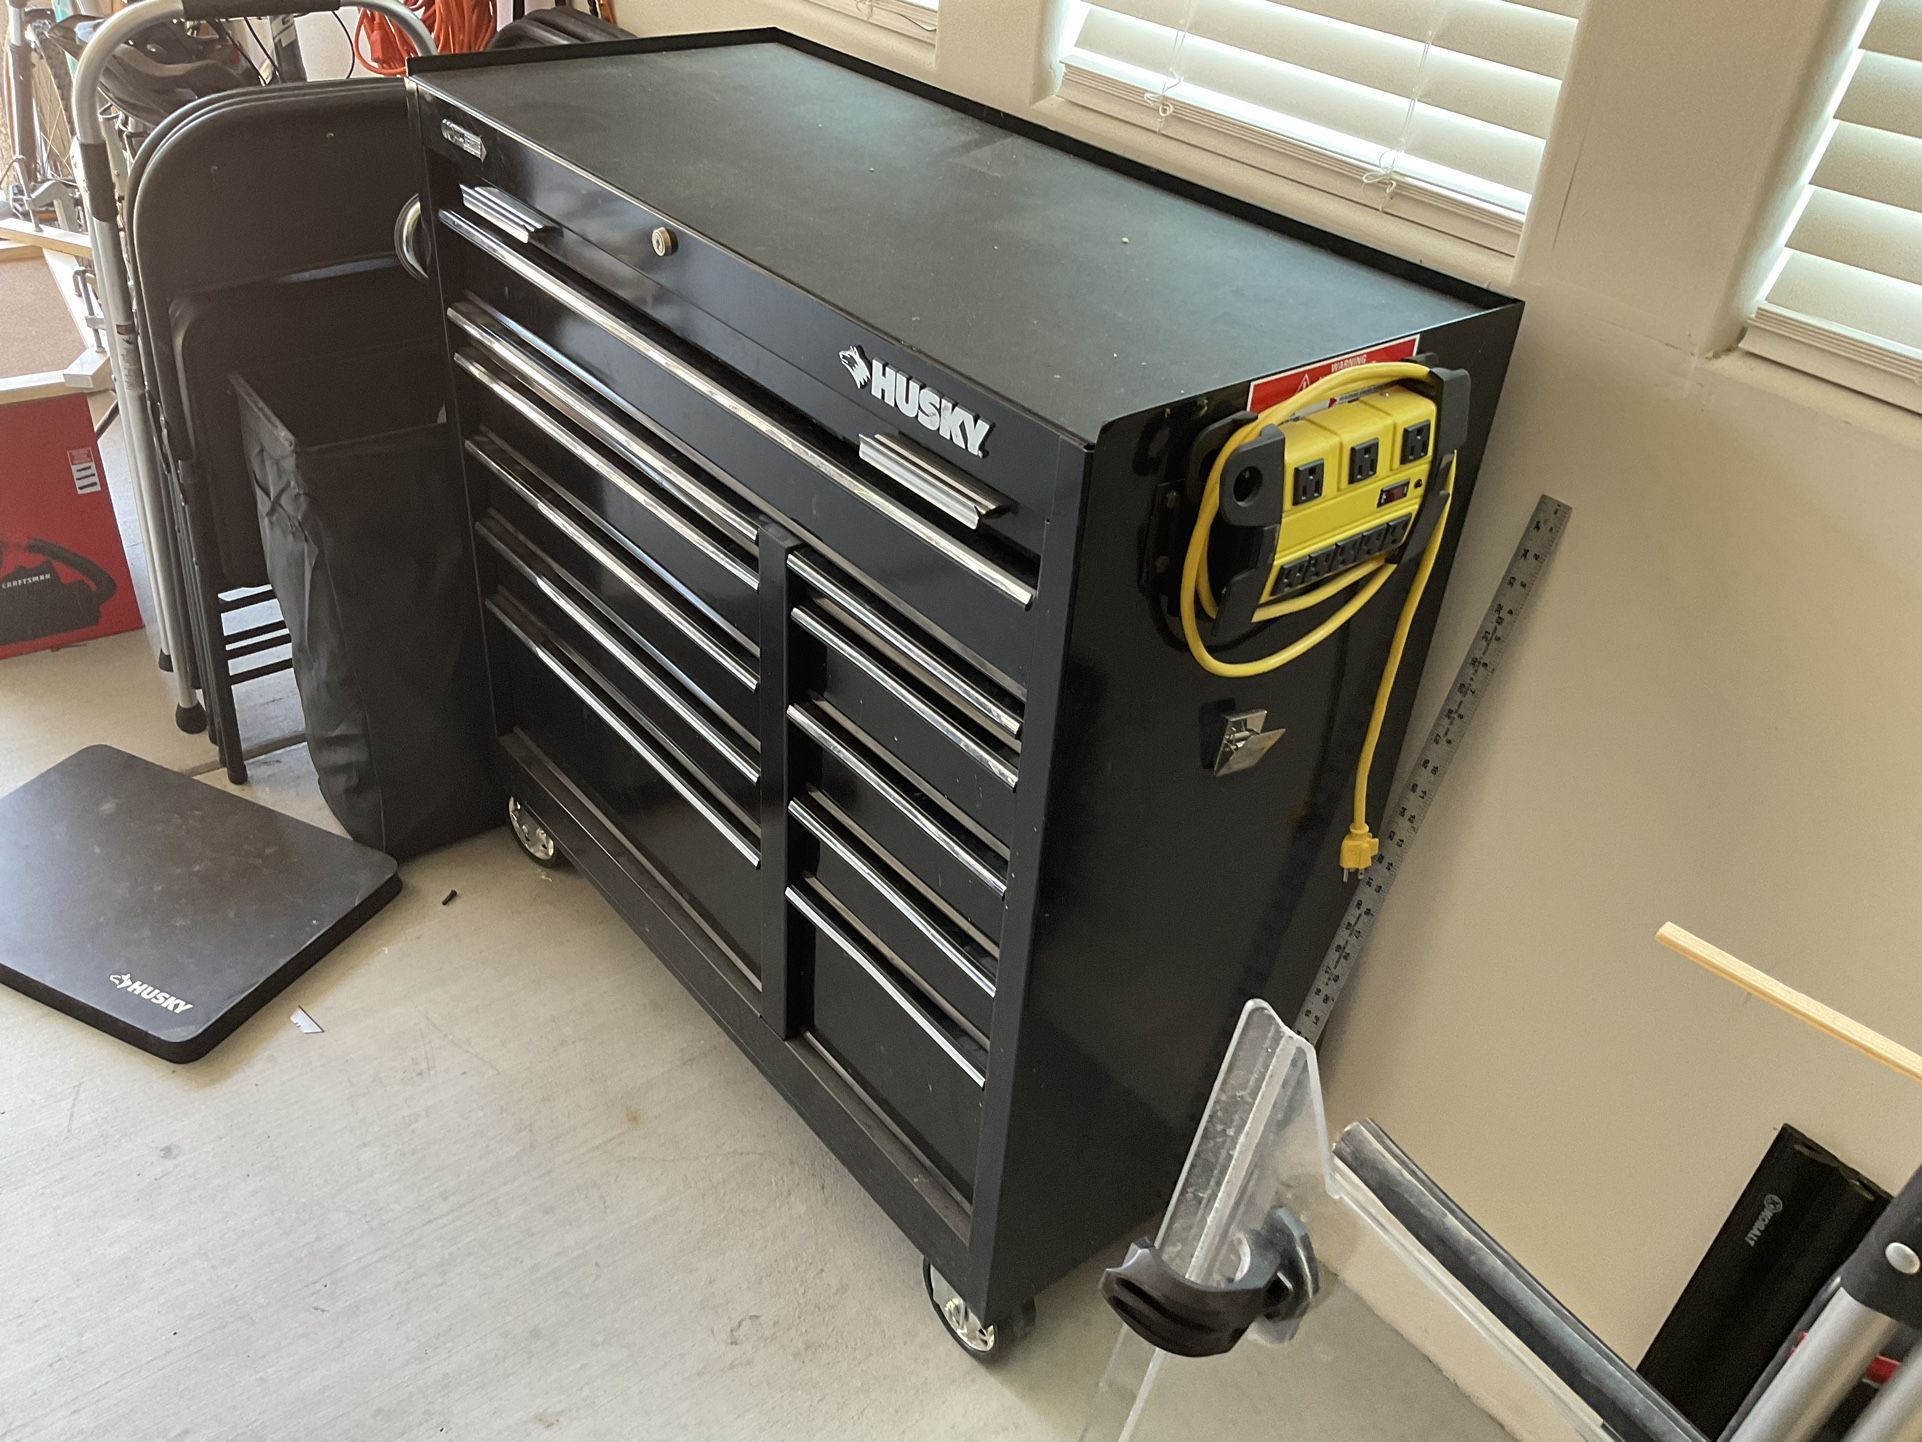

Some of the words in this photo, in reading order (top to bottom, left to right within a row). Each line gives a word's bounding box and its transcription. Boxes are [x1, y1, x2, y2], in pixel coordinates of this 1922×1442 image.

[1331, 353, 1368, 373] WARNING
[871, 356, 993, 457] HUSKY
[1, 573, 51, 589] CRAFTSMAN
[127, 981, 194, 1014] HUSKY
[1744, 1207, 1774, 1247] KOBALT
